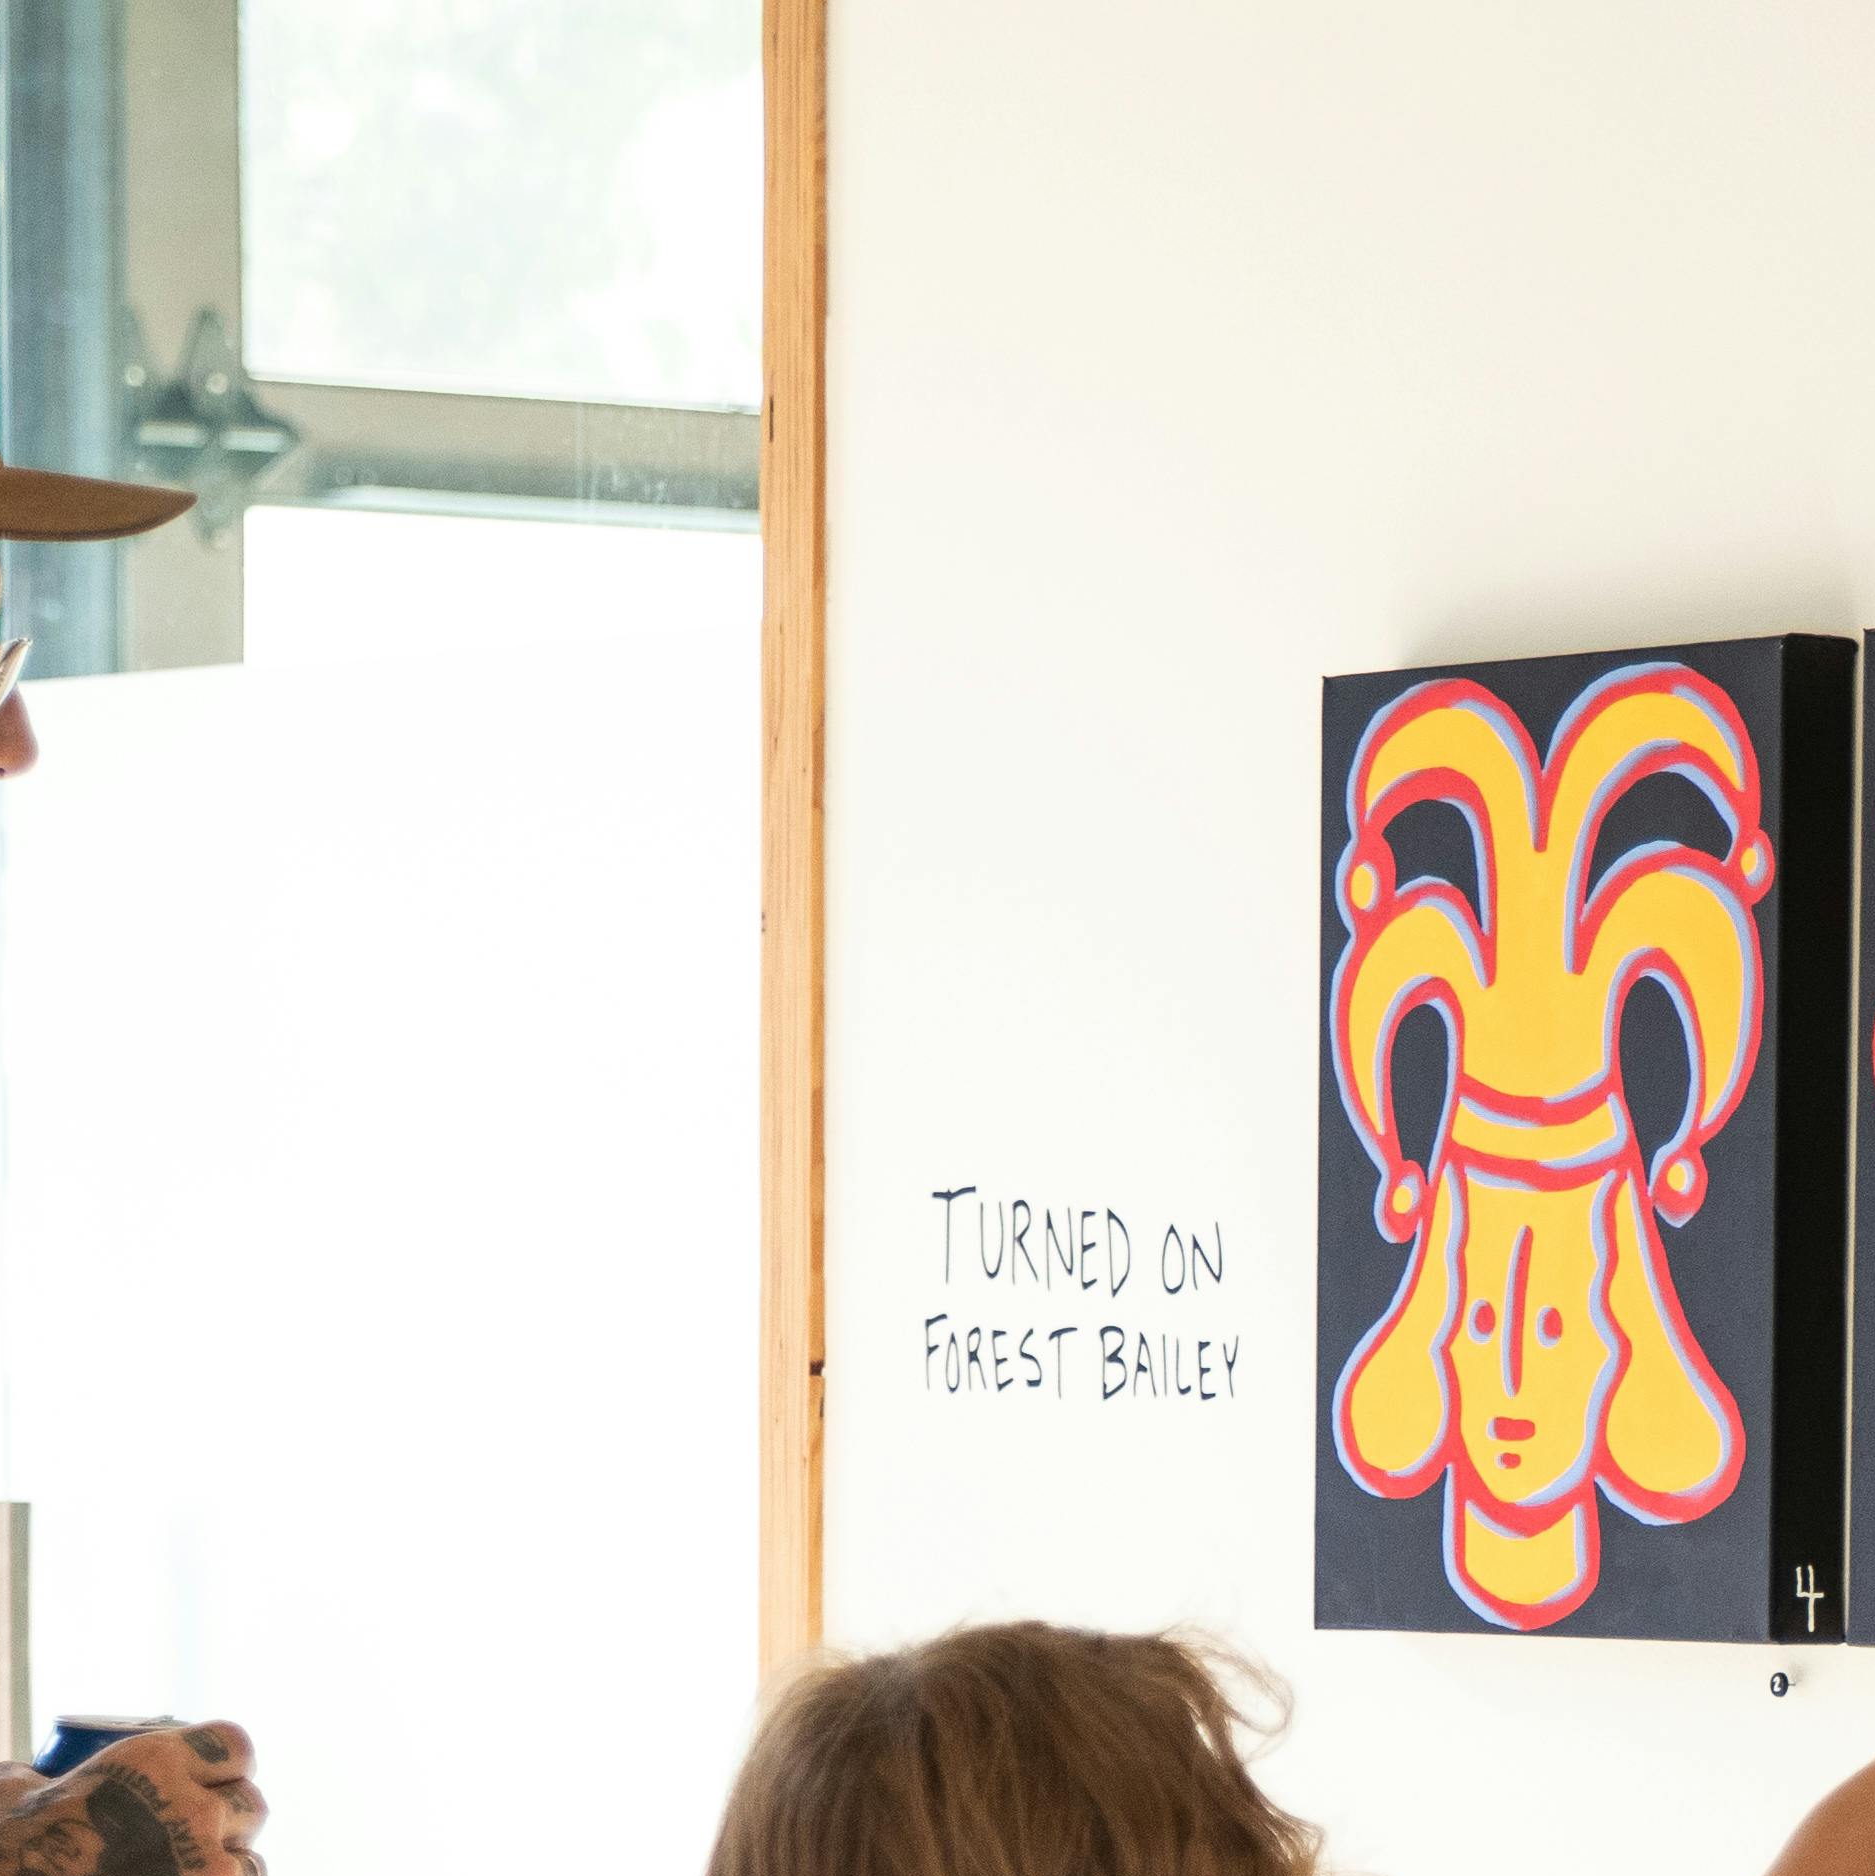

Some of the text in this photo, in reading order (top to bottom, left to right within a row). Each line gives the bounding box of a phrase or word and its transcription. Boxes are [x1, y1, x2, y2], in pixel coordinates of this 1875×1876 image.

[932, 1185, 1222, 1297] TURNED ON
[924, 1313, 1239, 1400] FOREST BAILEY
[1795, 1564, 1825, 1633] 4
